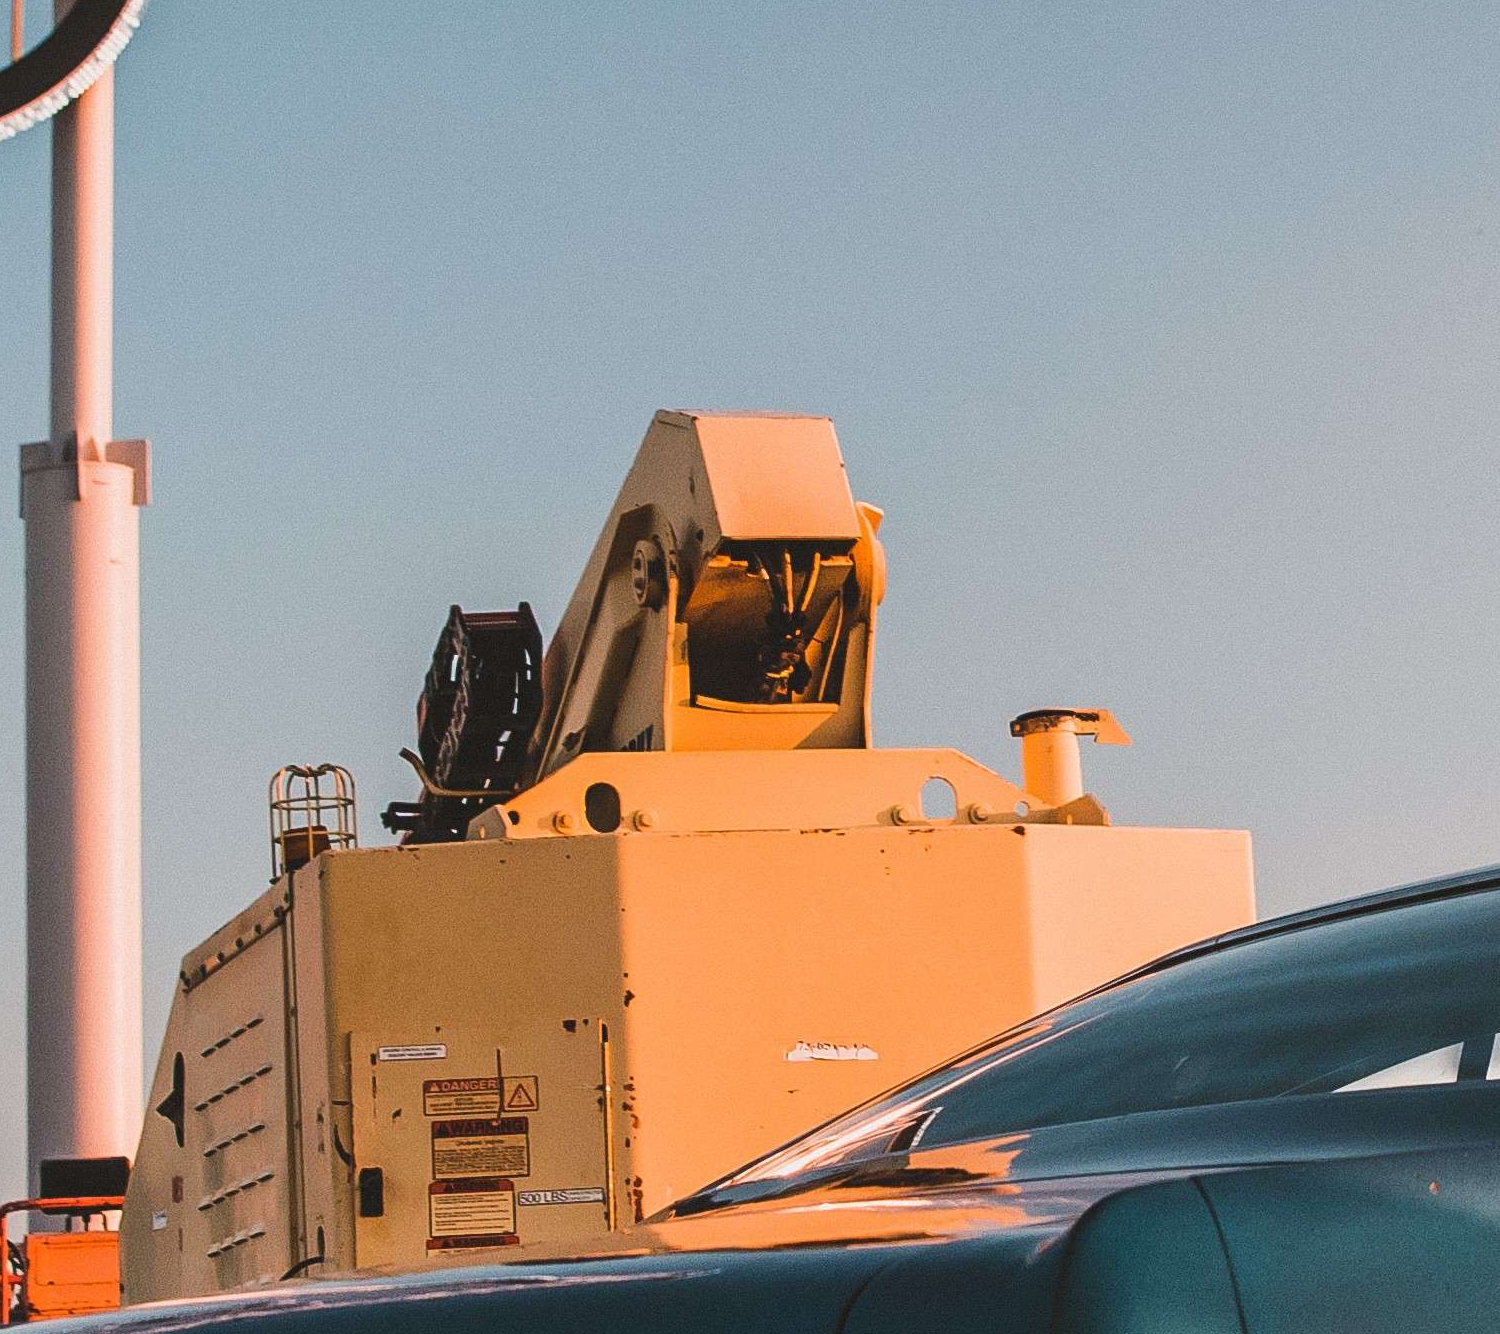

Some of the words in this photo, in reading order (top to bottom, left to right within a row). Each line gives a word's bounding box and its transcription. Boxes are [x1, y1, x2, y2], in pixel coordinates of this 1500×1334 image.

[441, 1079, 498, 1092] DANGER
[520, 1193, 542, 1204] 500
[544, 1191, 569, 1202] LBS
